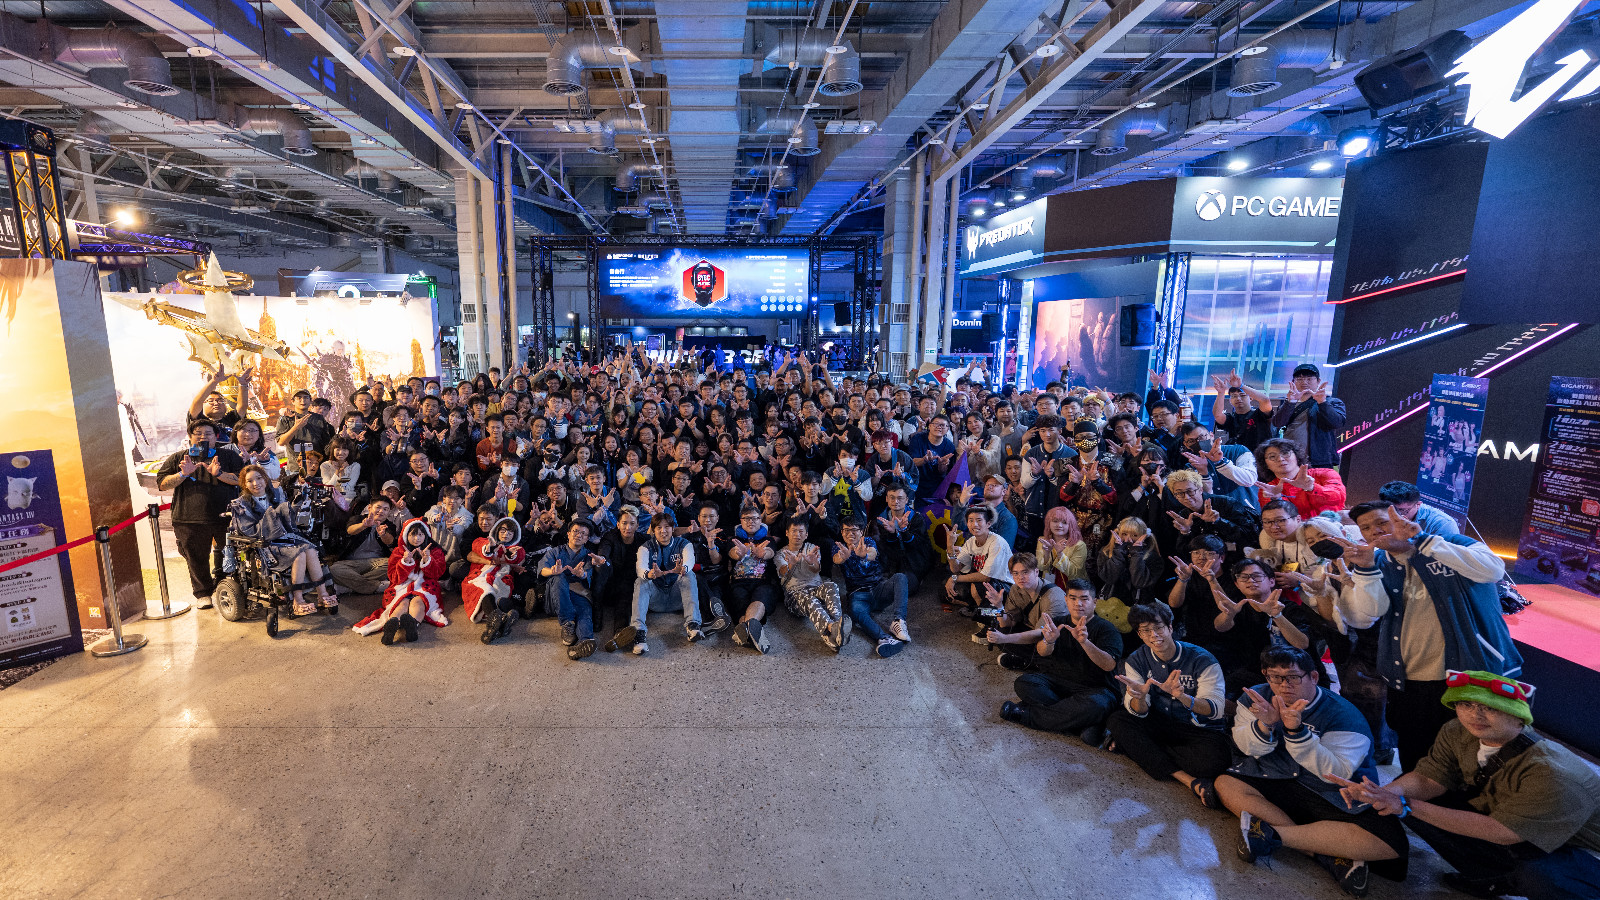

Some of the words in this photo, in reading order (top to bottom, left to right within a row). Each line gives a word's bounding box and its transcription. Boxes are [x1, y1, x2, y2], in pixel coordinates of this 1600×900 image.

[1230, 195, 1265, 216] PC
[1268, 195, 1340, 217] GAME
[979, 215, 1034, 248] PREDATOR
